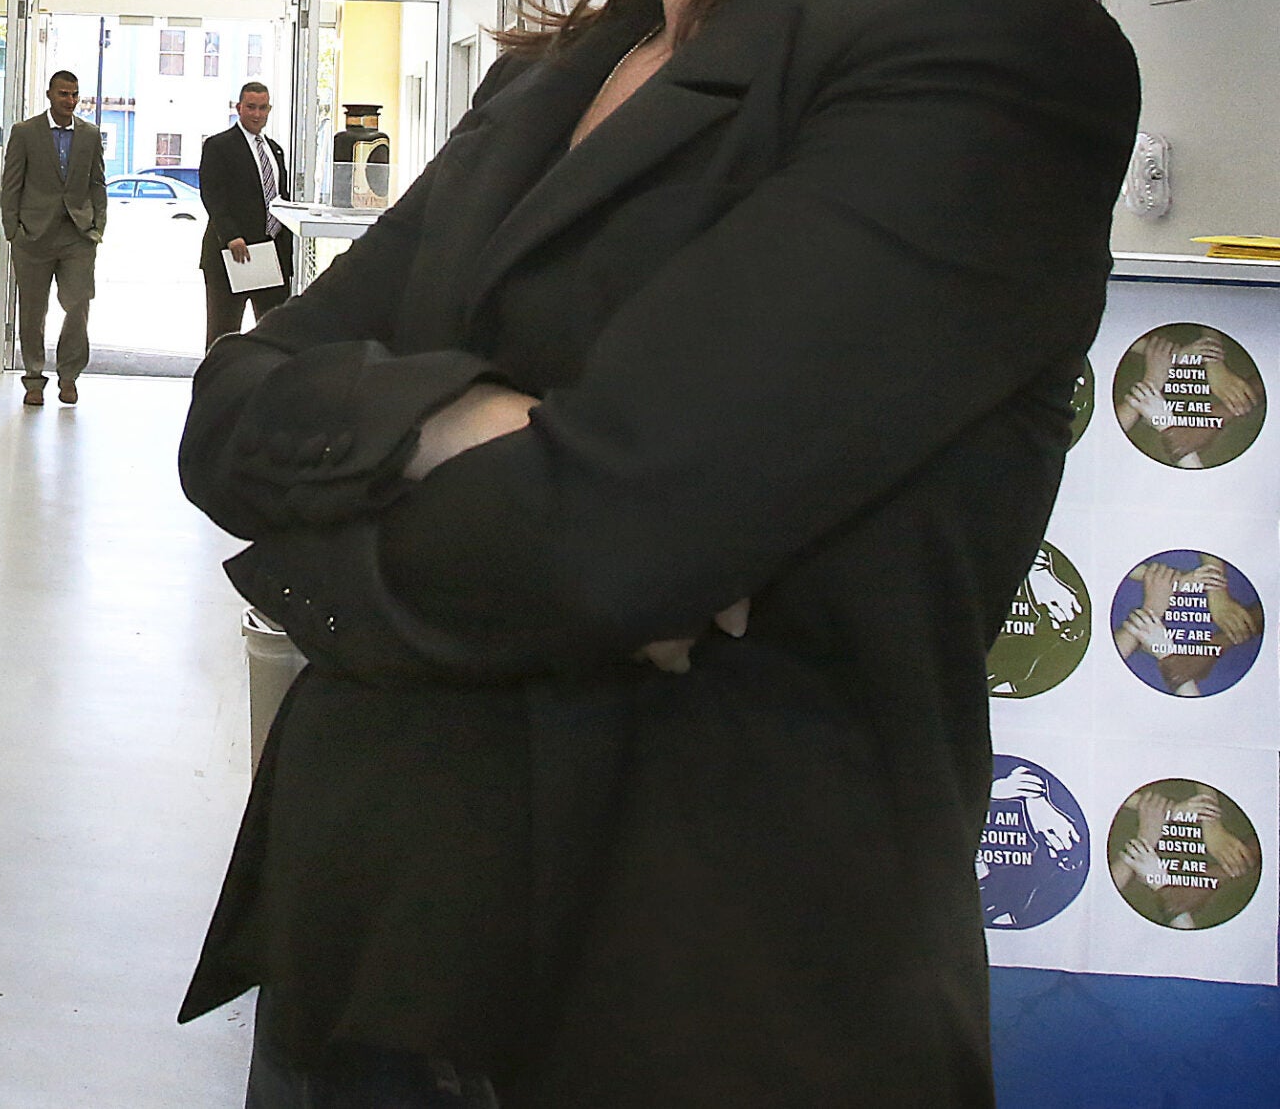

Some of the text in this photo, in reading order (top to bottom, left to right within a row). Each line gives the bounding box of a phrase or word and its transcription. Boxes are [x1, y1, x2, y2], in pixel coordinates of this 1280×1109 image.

[1178, 354, 1203, 366] AM
[1168, 368, 1206, 380] SOUTH
[1164, 383, 1210, 395] BOSTON
[1163, 401, 1212, 413] WE ARE
[1151, 415, 1224, 429] COMMUNITY
[1180, 582, 1204, 594] AM
[1169, 596, 1207, 608] SOUTH
[1165, 610, 1211, 623] BOSTON
[1001, 620, 1036, 636] TON
[1163, 628, 1211, 641] WE ARE
[1151, 643, 1222, 657] COMMUNITY
[995, 811, 1019, 826] AM
[1172, 811, 1197, 823] AM
[980, 830, 1027, 846] SOUTH
[1162, 825, 1202, 839] SOUTH
[1158, 840, 1206, 855] BOSTON
[1157, 859, 1207, 873] WE ARE
[1146, 873, 1218, 889] COMMUNITY
